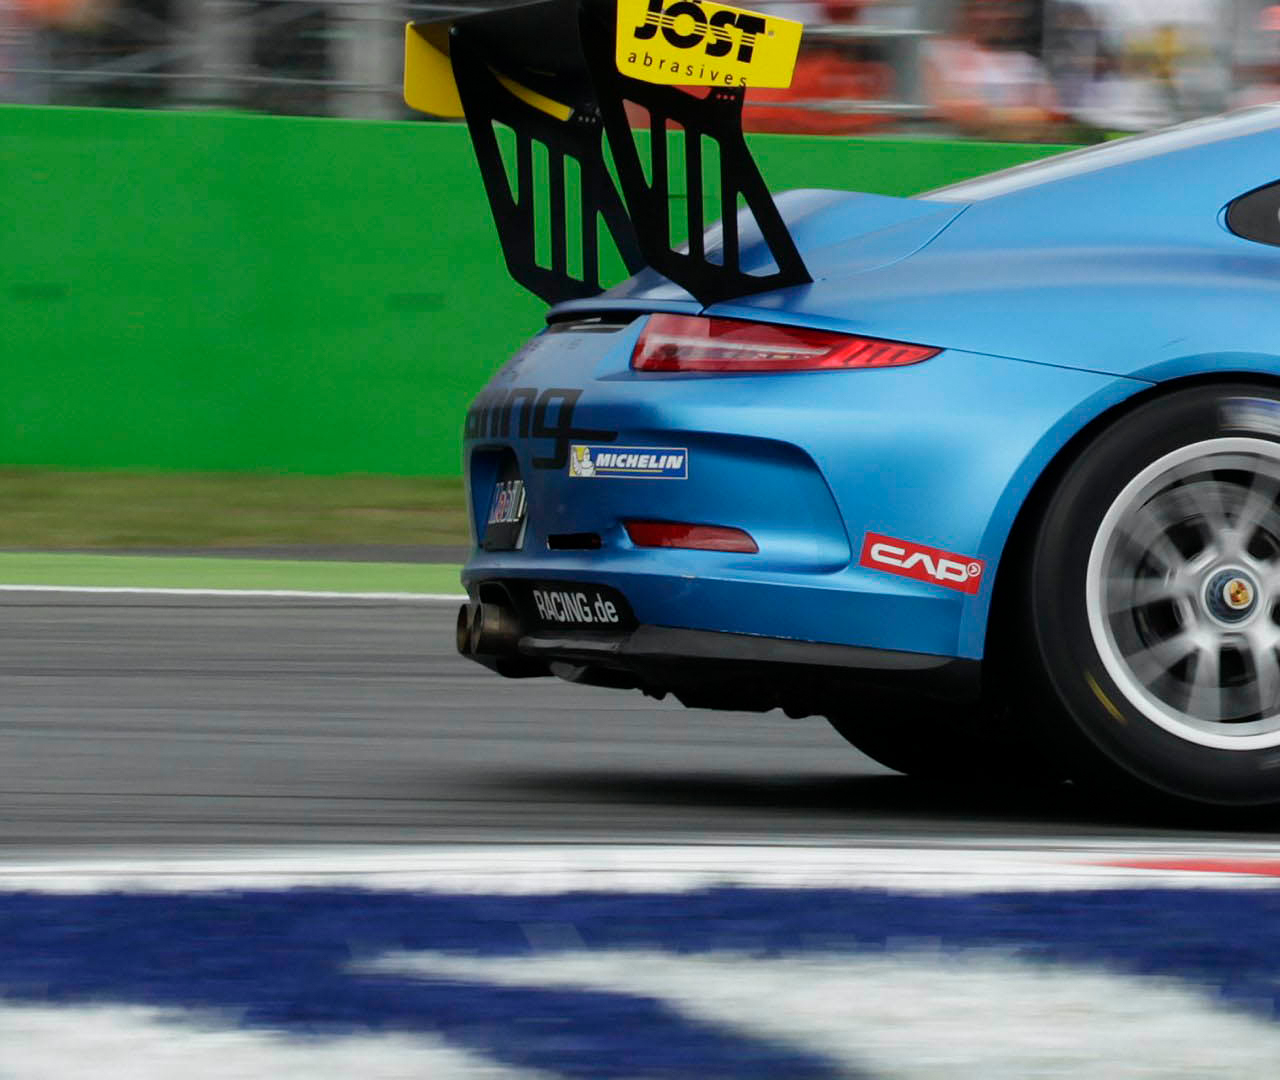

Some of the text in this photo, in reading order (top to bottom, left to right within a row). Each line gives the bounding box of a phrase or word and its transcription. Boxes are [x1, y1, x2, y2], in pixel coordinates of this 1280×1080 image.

[628, 51, 748, 88] abrasives
[595, 453, 683, 469] MICHELIN
[533, 589, 620, 623] RACING.de
